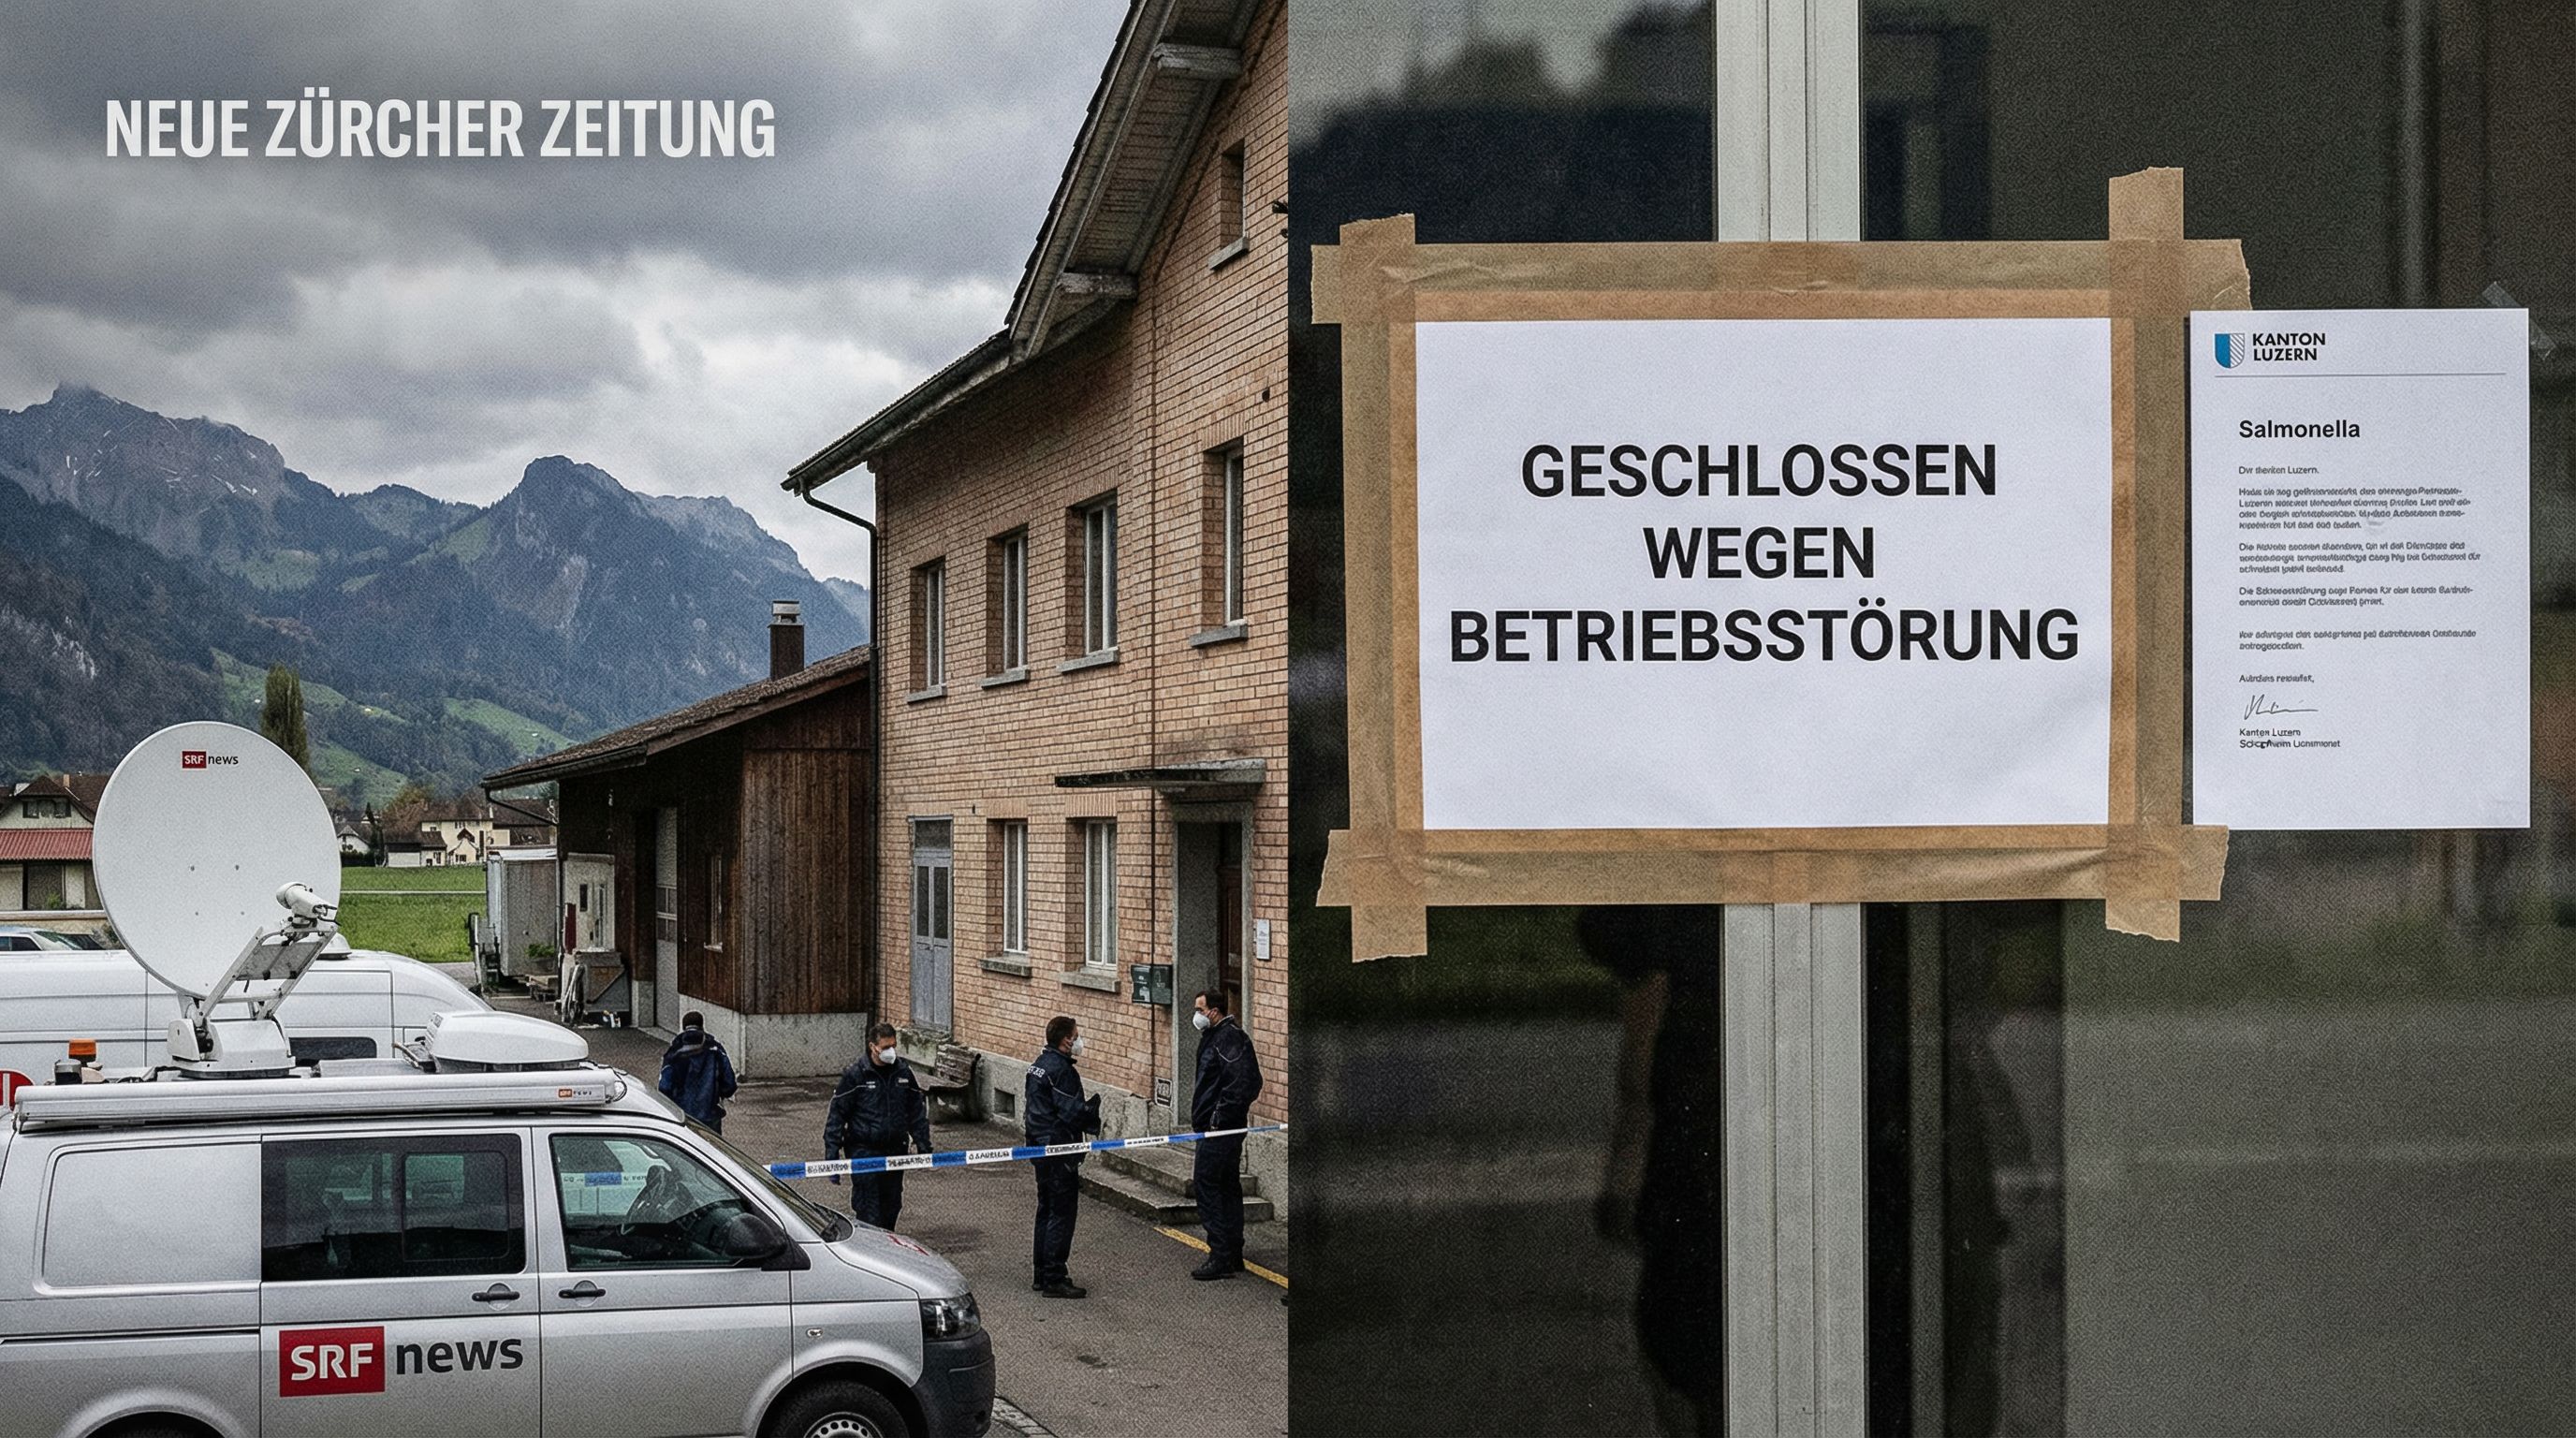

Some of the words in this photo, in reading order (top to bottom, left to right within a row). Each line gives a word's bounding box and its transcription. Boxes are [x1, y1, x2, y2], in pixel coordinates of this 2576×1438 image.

[2252, 332, 2326, 347] KANTON
[2253, 347, 2319, 361] LUZERN
[2238, 420, 2361, 439] Salmonella
[1521, 444, 1997, 498] GESCHLOSSEN
[1643, 526, 1875, 580] WEGEN
[1450, 596, 2079, 663] BETRIEBSSTÖRUNG
[183, 755, 204, 765] SRF
[208, 756, 239, 765] news
[290, 1342, 374, 1381] SRF
[396, 1338, 524, 1375] news
